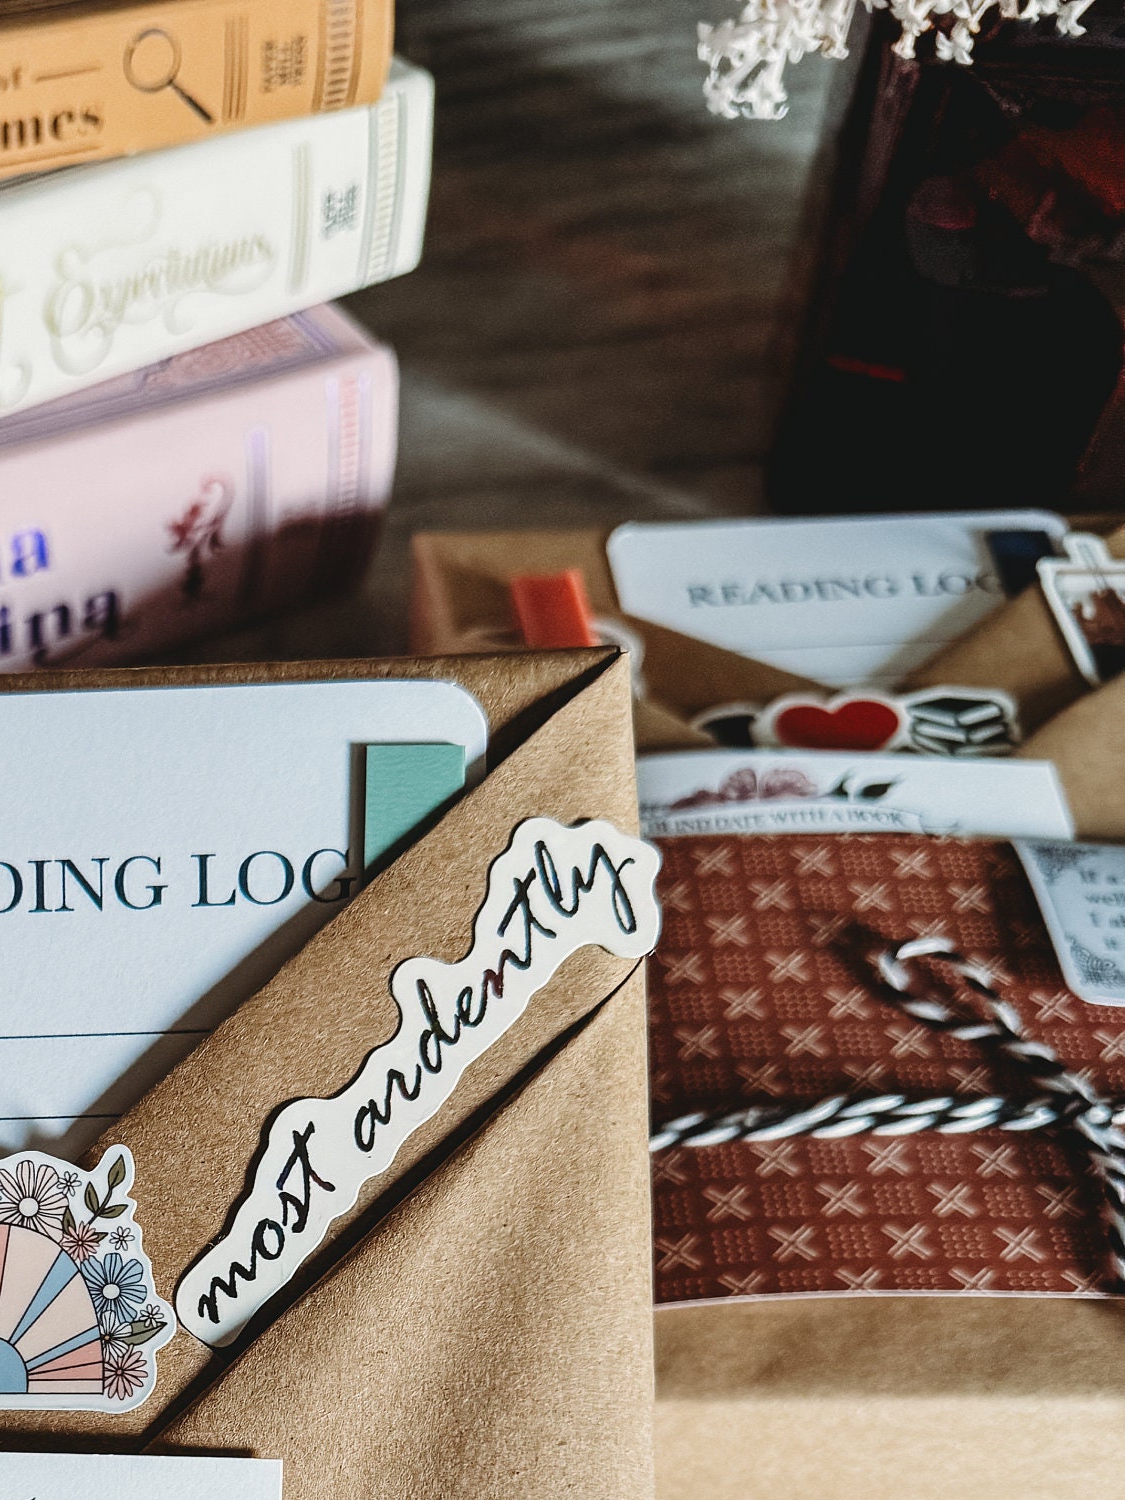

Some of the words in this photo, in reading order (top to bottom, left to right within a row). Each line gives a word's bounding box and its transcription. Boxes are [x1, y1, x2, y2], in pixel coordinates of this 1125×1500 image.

[687, 573, 898, 608] READING
[190, 848, 356, 908] LOG
[198, 1121, 336, 1324] most
[354, 839, 636, 1153] ardently
